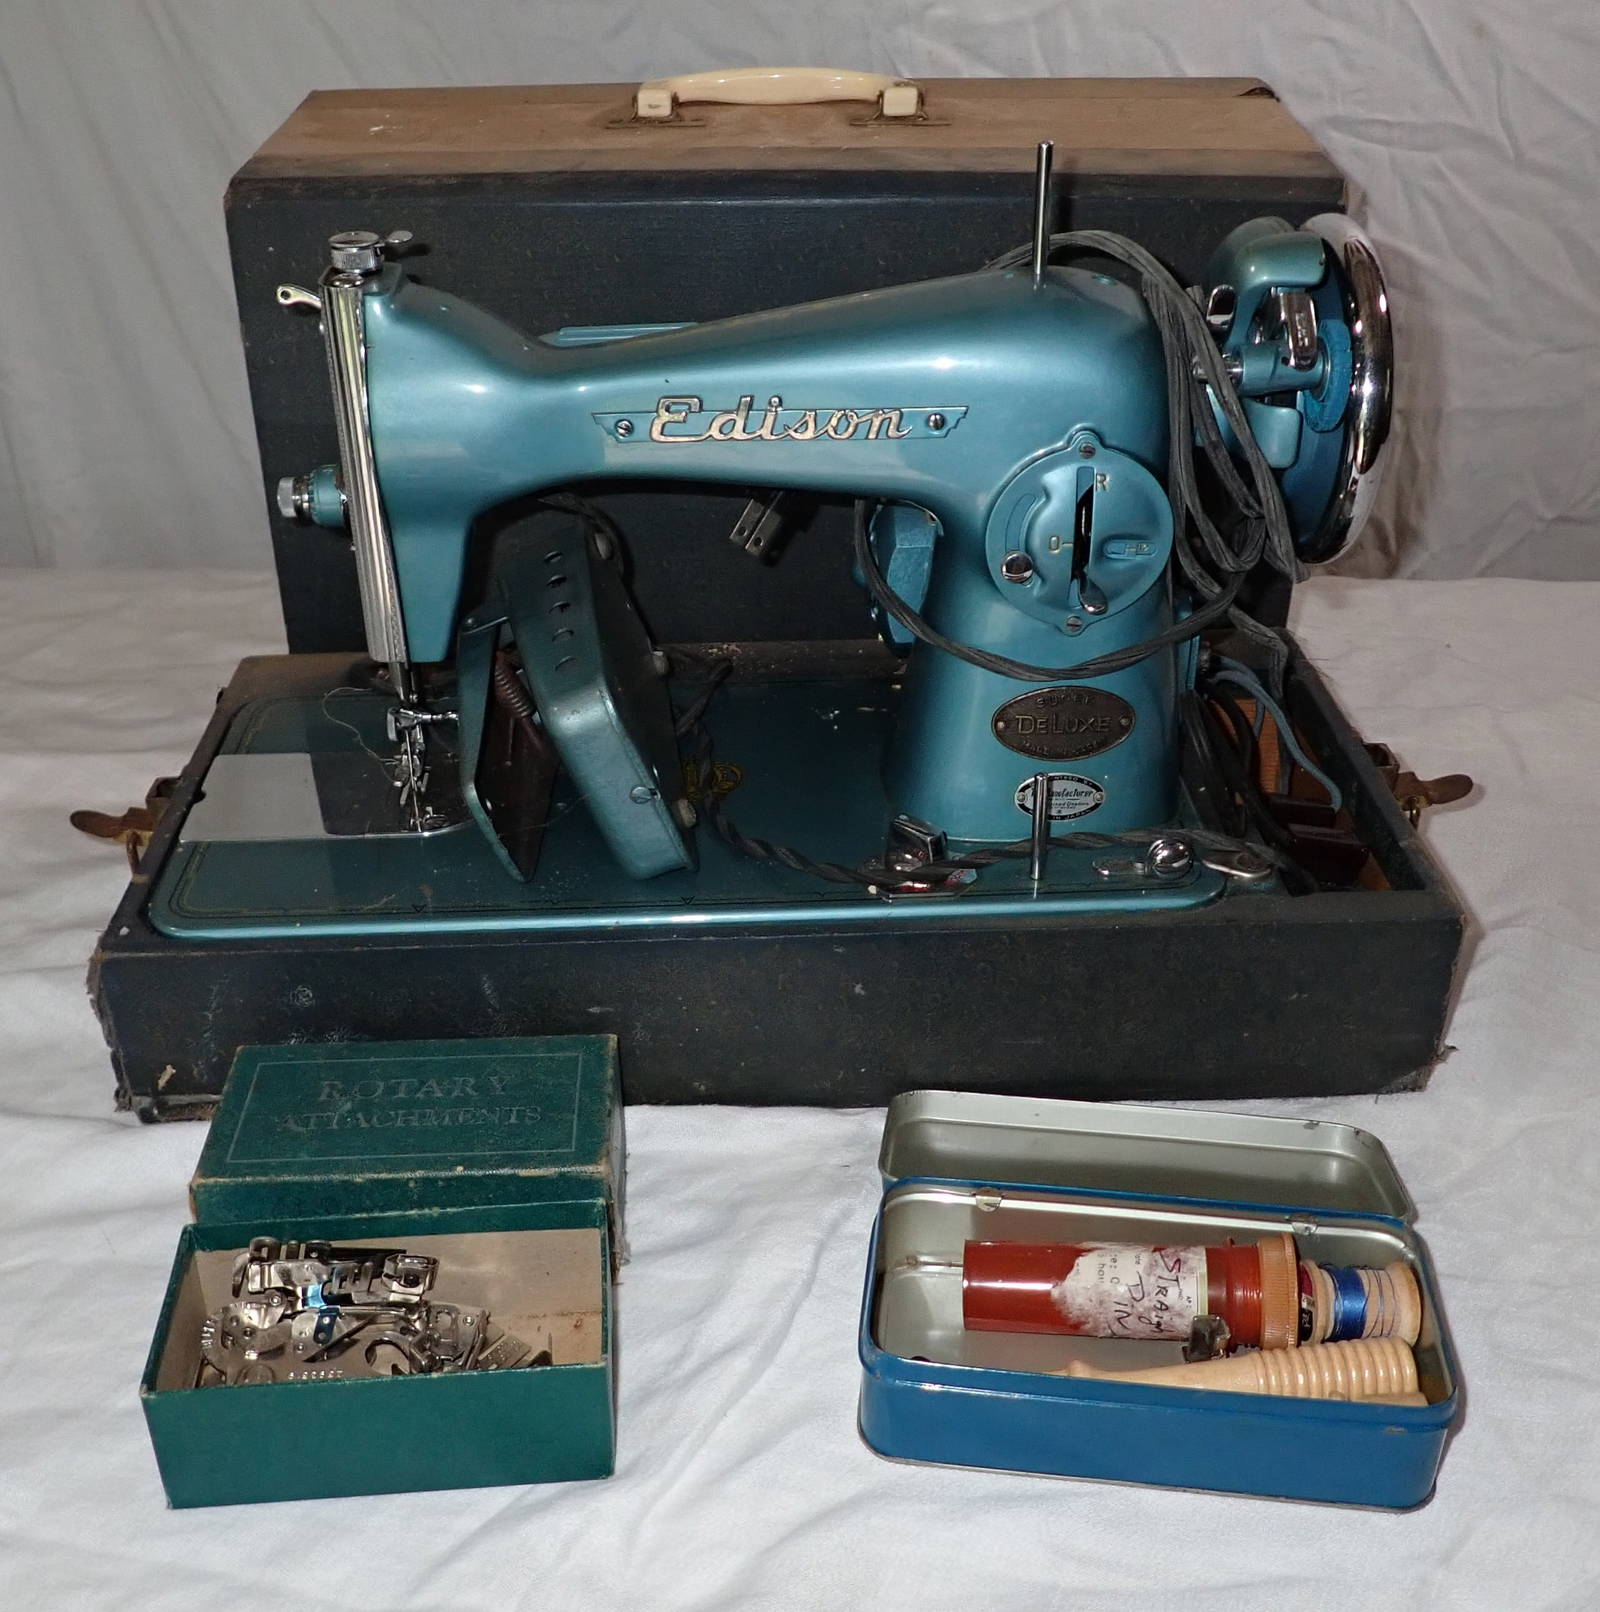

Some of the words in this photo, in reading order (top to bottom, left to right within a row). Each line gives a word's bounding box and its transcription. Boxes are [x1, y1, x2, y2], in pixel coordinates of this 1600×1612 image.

[649, 394, 912, 443] Edison
[1095, 472, 1110, 492] R
[318, 1075, 516, 1101] ROTARY
[275, 1104, 544, 1132] ATTACHMENTS
